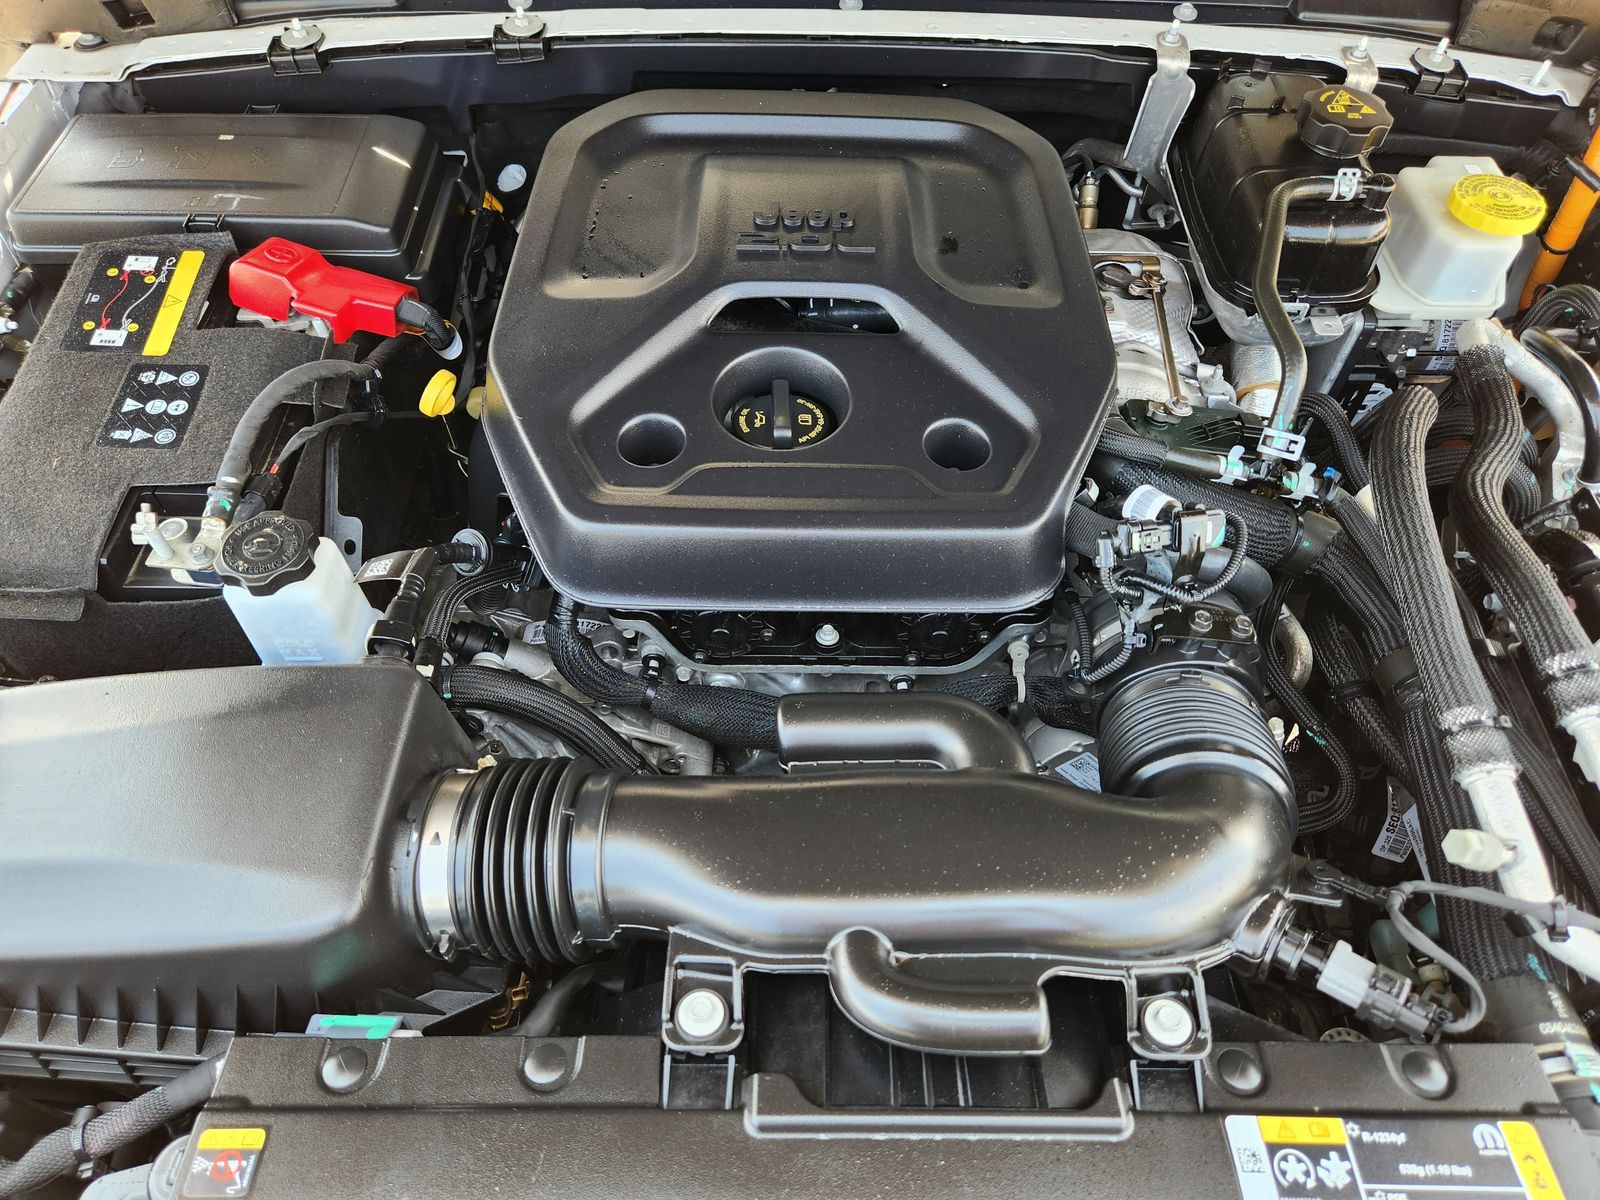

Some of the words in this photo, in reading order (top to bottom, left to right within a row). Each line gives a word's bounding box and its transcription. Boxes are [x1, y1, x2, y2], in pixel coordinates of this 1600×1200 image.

[753, 202, 855, 232] Jeep
[740, 407, 751, 416] OIL
[738, 415, 751, 434] ENGINE
[798, 435, 812, 444] API
[234, 522, 252, 537] USE
[253, 515, 296, 532] APPROVED
